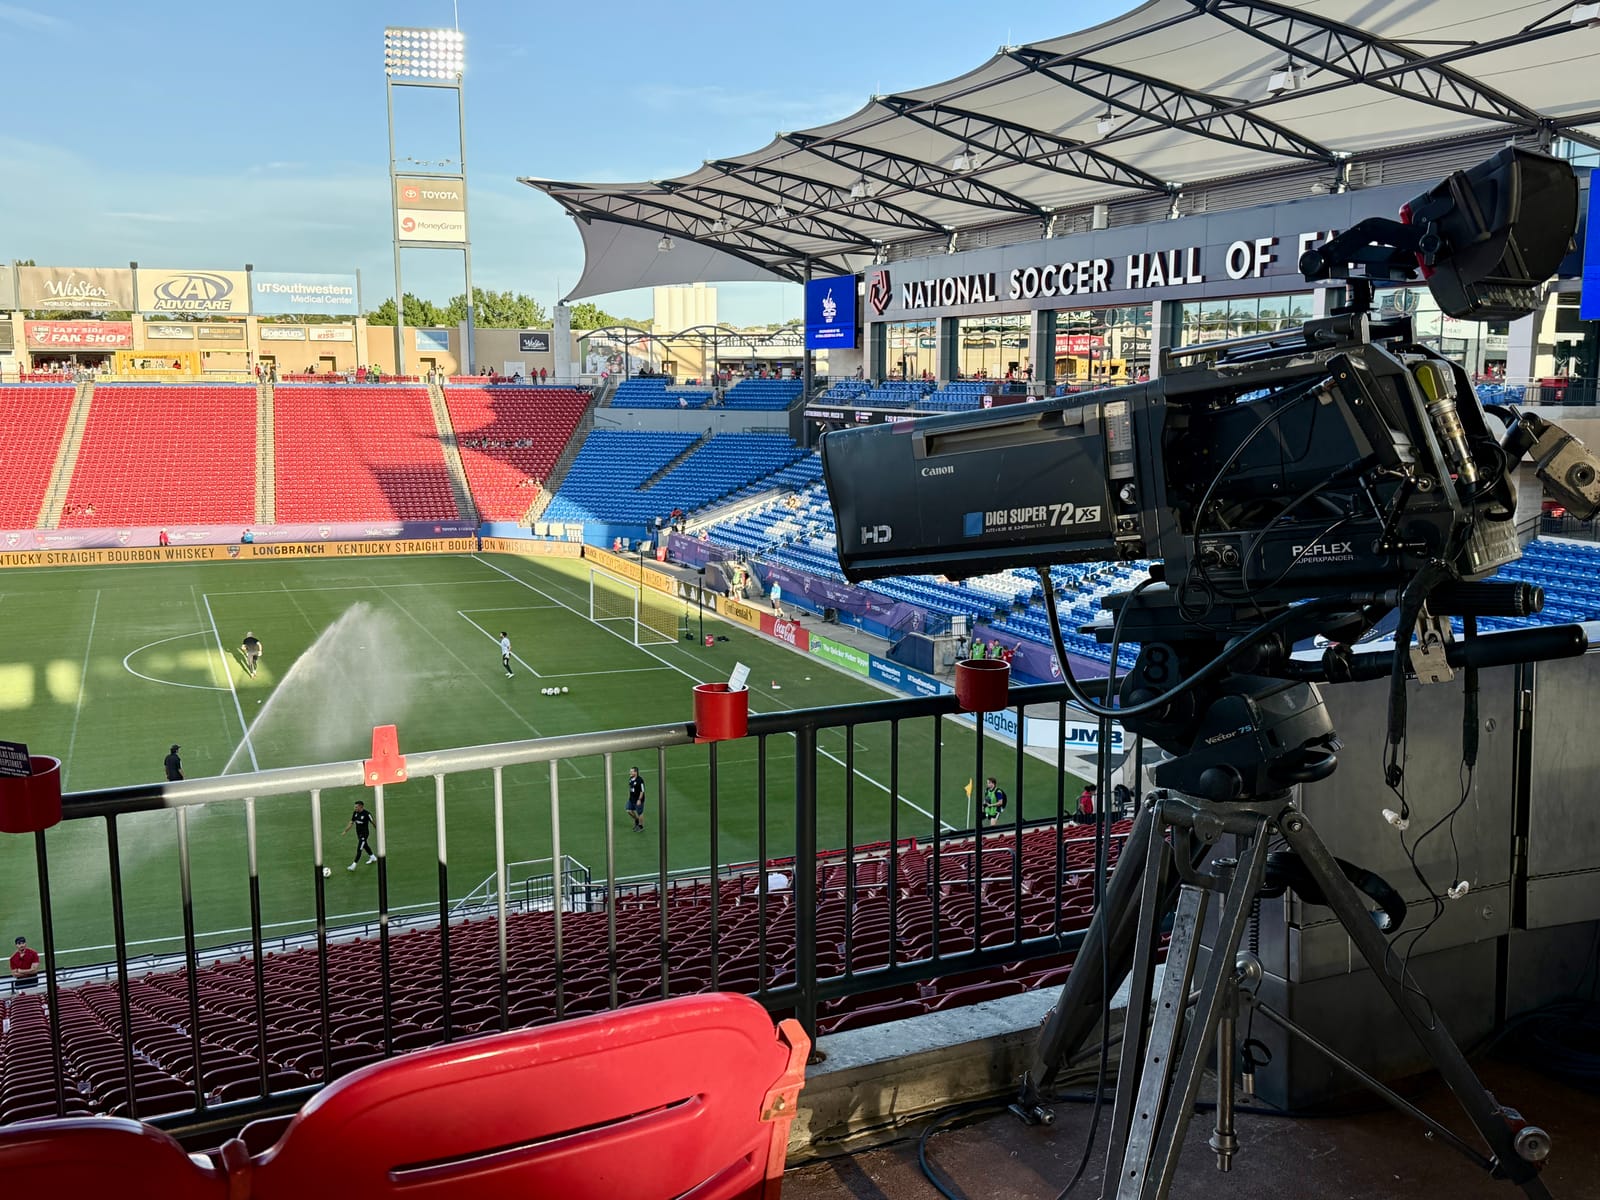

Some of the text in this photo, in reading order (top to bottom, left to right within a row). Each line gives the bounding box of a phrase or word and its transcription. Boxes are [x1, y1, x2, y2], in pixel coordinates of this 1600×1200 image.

[421, 190, 459, 200] TOYOTA
[418, 221, 462, 231] MoneyGram
[903, 272, 998, 309] NATIONAL
[1009, 258, 1112, 300] SOCCER
[1126, 246, 1202, 289] HALL
[1225, 237, 1274, 280] OF
[43, 271, 109, 299] WinStar
[154, 299, 232, 310] ADVOCARE
[290, 295, 353, 304] Medical Center
[51, 334, 126, 343] FAN SHOP
[921, 465, 955, 477] Canon
[985, 510, 1008, 526] DIGI
[1010, 505, 1047, 523] SUPER
[1049, 502, 1075, 527] 72
[861, 525, 892, 545] HD
[253, 545, 325, 556] LONGBRANCH
[336, 542, 392, 555] KENTUCKY
[395, 541, 444, 553] STRAIGHT
[1292, 541, 1352, 557] REFLEX
[0, 547, 216, 566] NTUCKY STRAIGHT BOURBON WHISKEY
[1205, 724, 1253, 745] Vector 75
